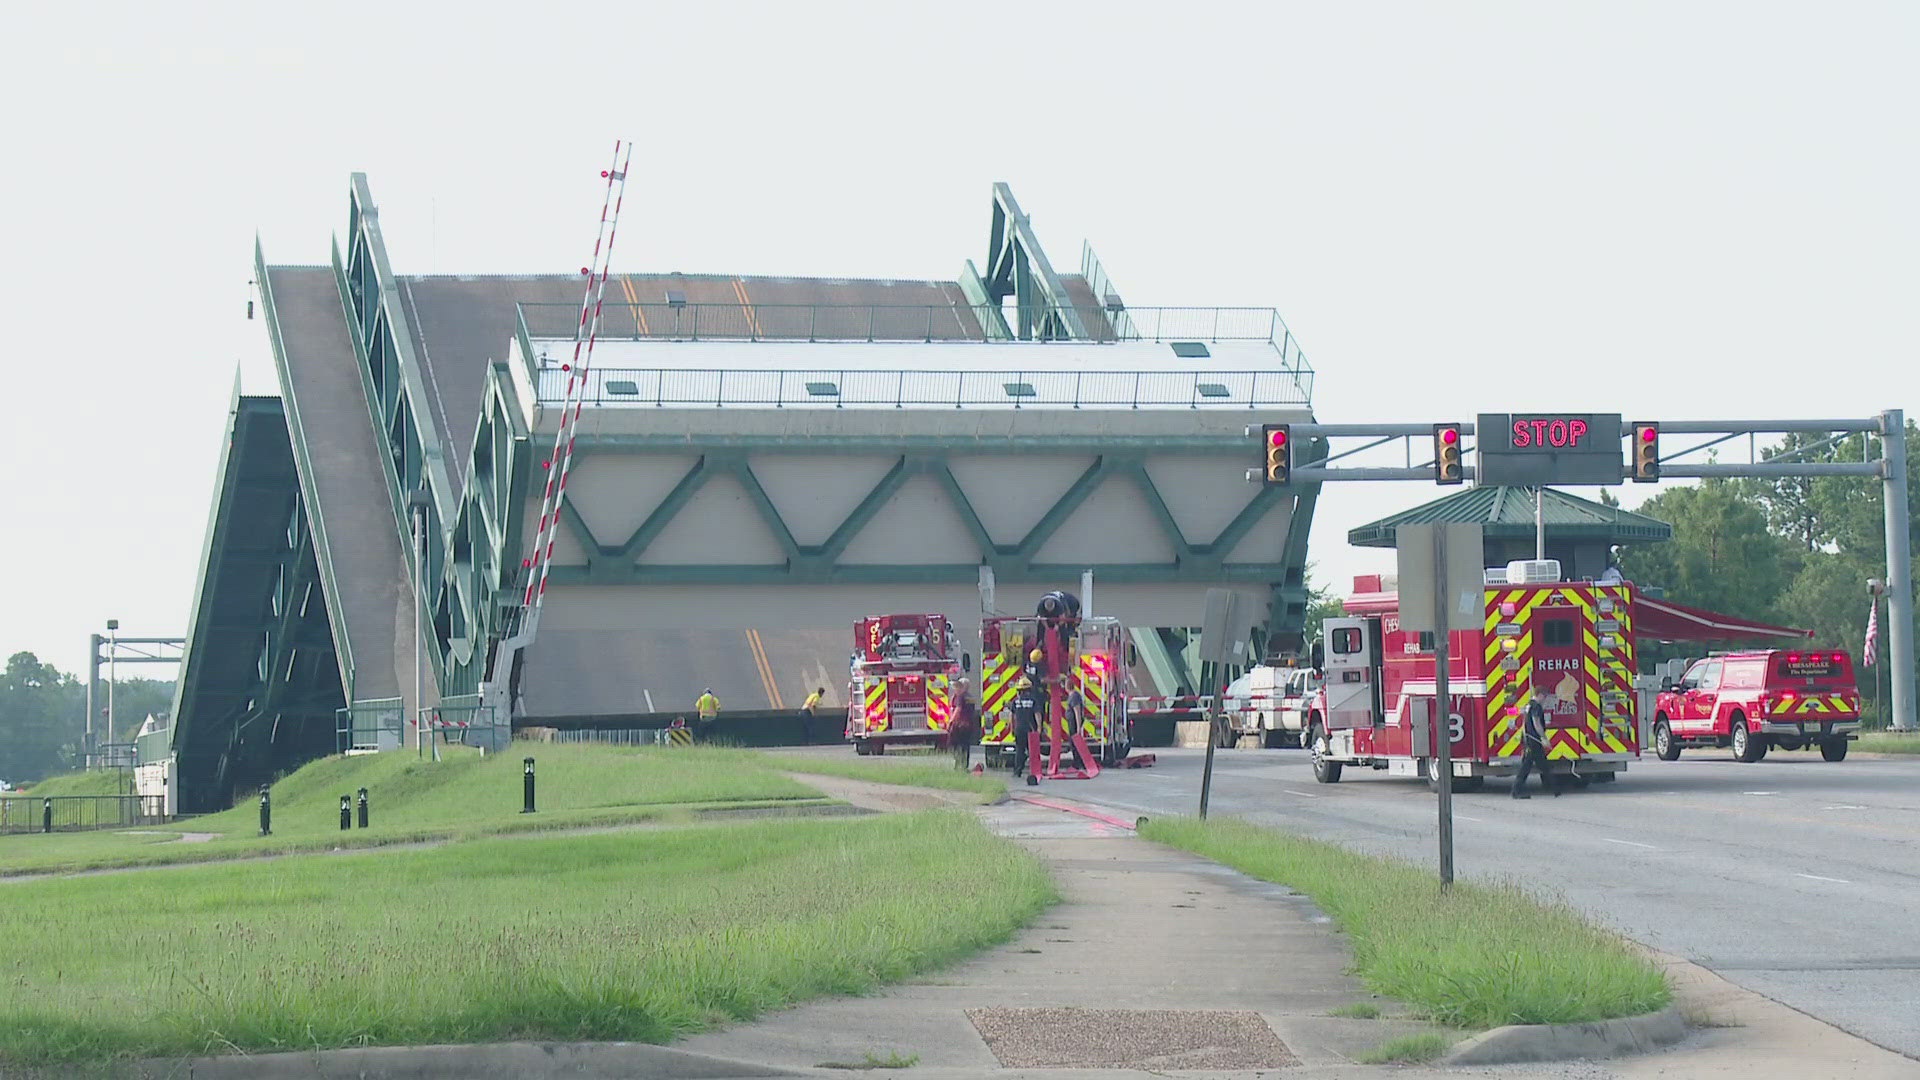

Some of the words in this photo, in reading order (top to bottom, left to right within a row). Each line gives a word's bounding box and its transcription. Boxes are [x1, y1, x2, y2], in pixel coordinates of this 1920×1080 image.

[1513, 419, 1588, 448] STOP
[932, 628, 941, 644] 5
[1403, 642, 1421, 655] REHAB
[1538, 658, 1580, 671] REHAB
[1788, 661, 1830, 669] CHESAPEAKE
